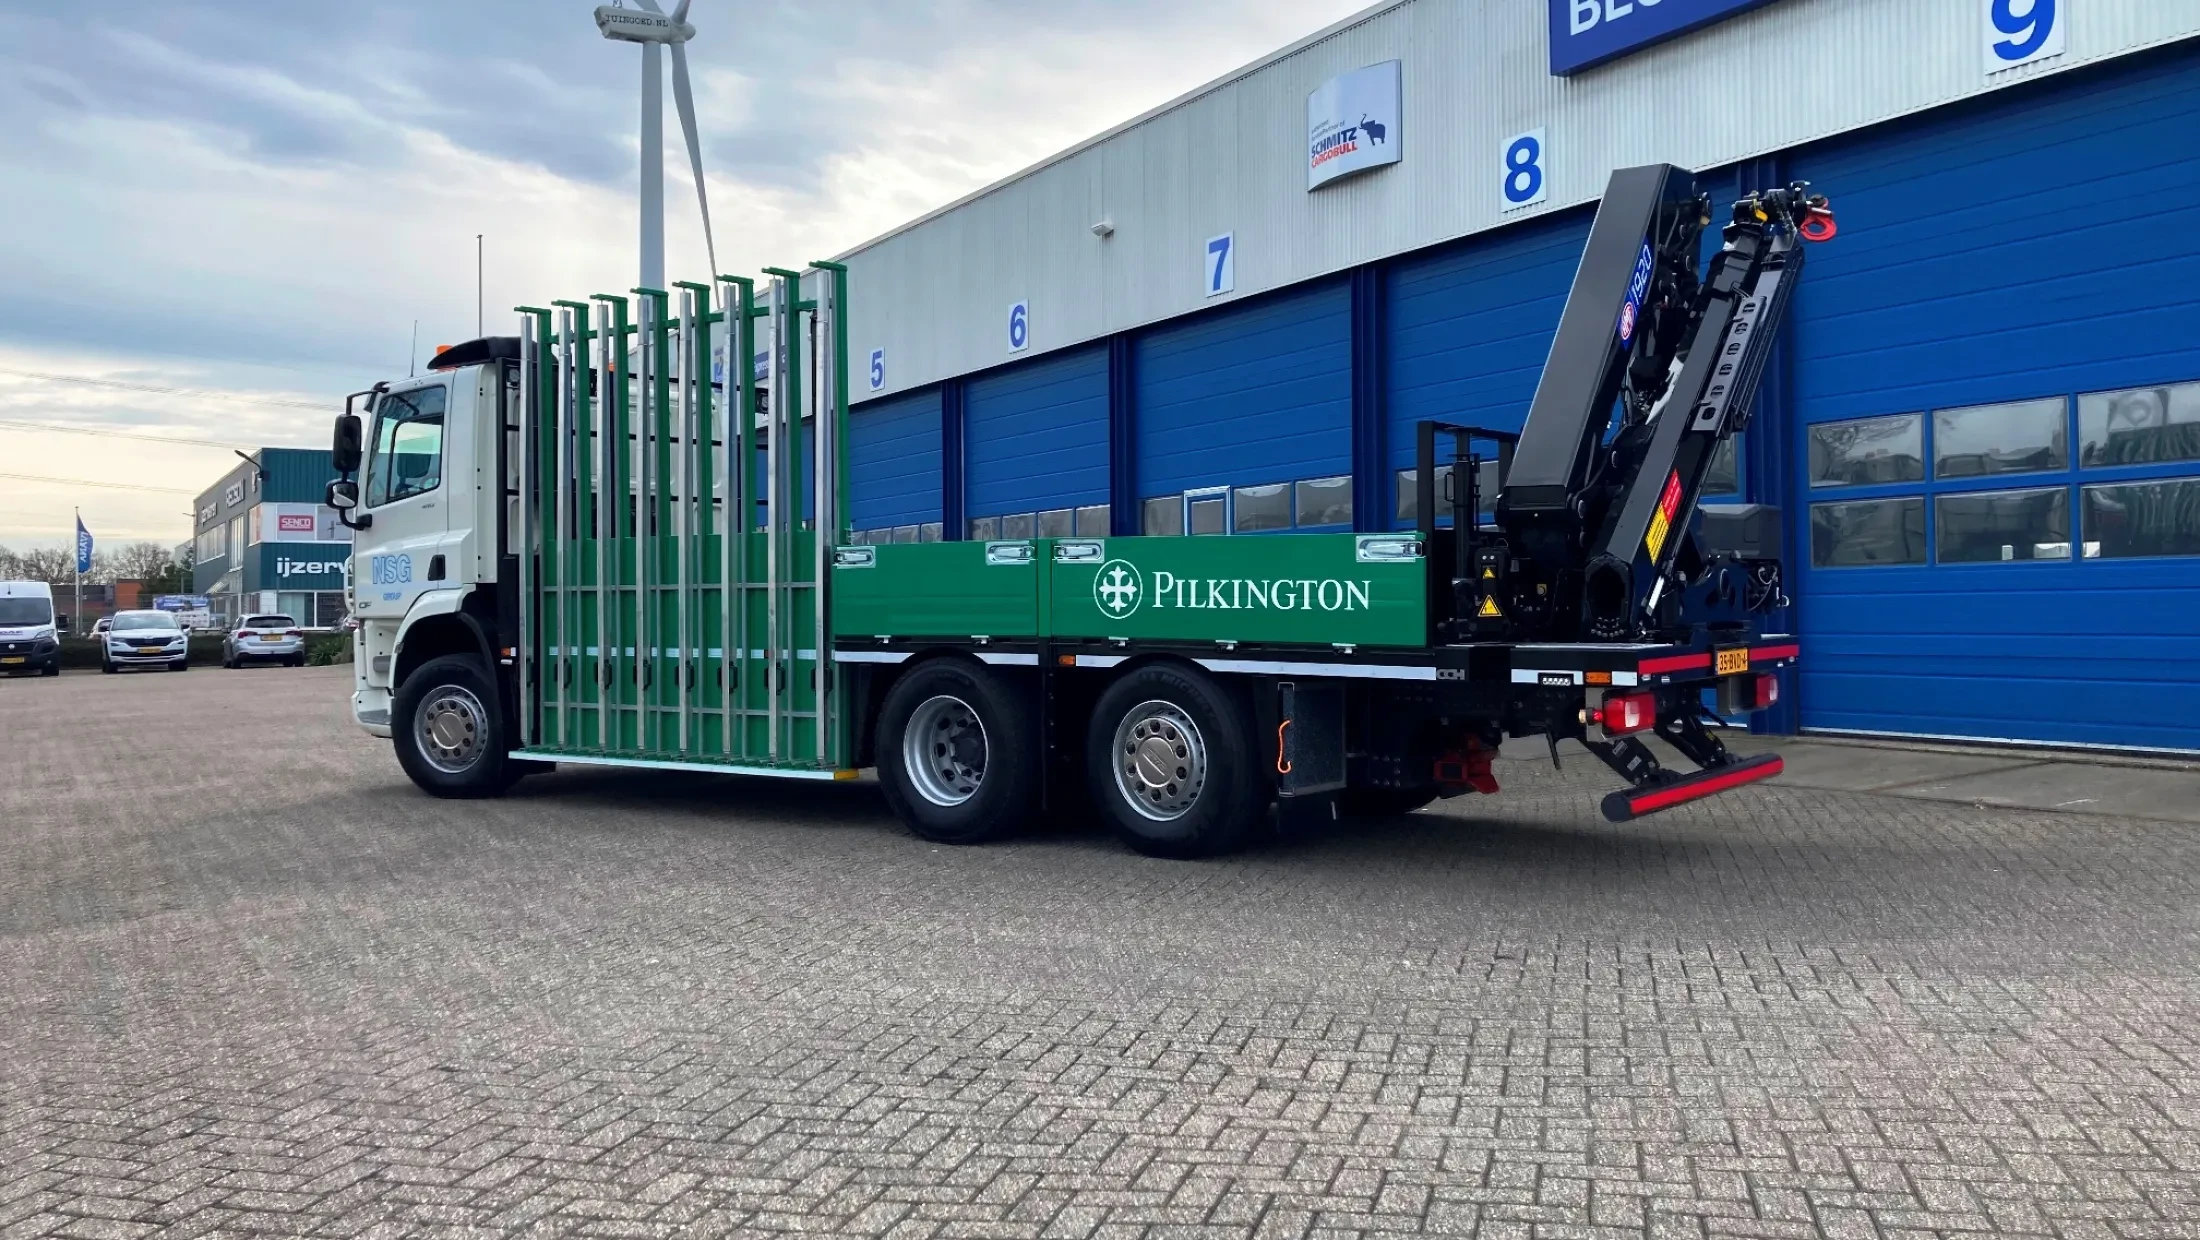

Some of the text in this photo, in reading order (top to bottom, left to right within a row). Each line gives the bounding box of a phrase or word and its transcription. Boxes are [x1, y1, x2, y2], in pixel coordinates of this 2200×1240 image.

[1991, 0, 2056, 61] 9
[1311, 127, 1357, 159] SCHMITZ
[1311, 141, 1358, 169] CARGOBULL
[1504, 136, 1543, 203] 8
[1208, 236, 1230, 292] 7
[1632, 243, 1652, 306] 1920
[1009, 304, 1027, 348] 6
[871, 350, 884, 388] 5
[282, 517, 311, 528] SENCO
[372, 553, 412, 585] NSG
